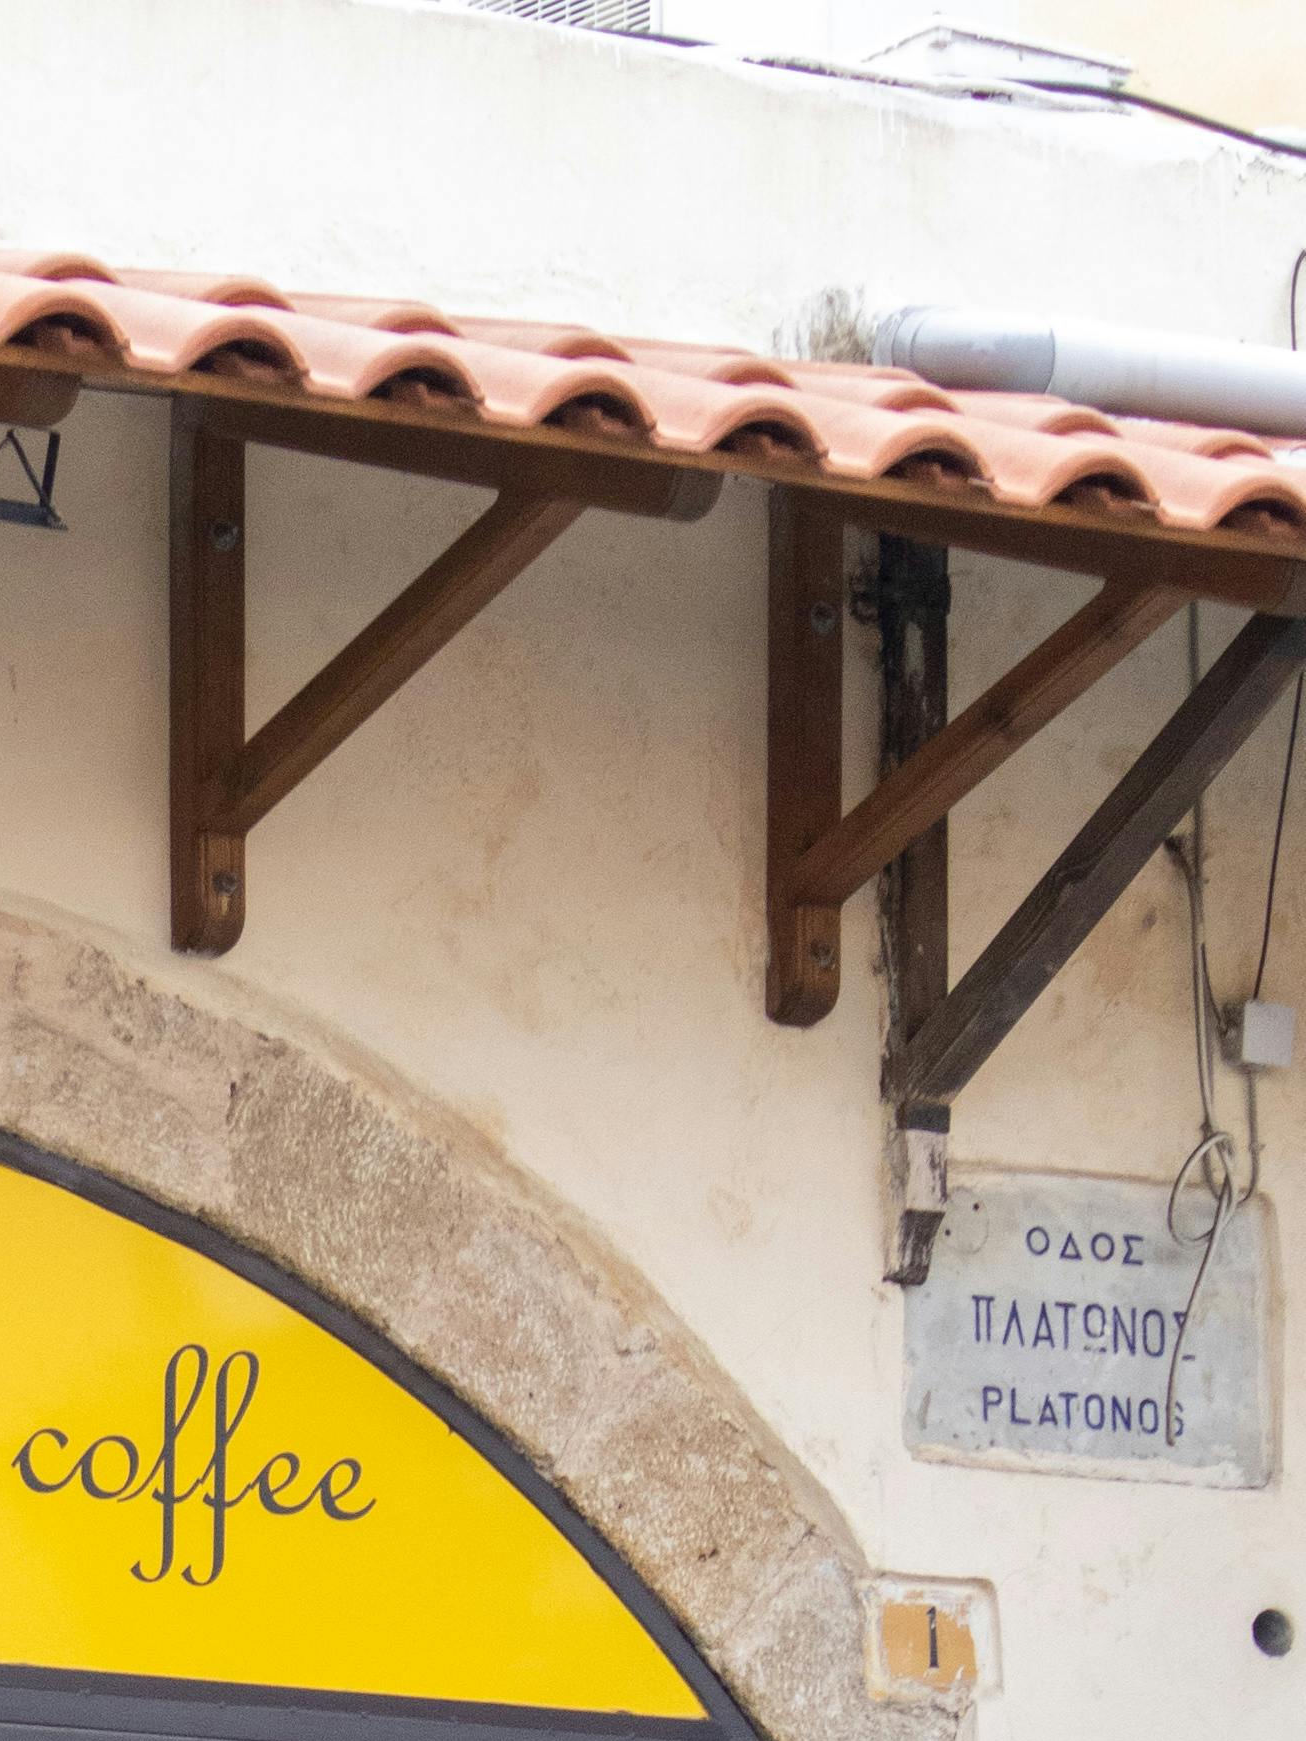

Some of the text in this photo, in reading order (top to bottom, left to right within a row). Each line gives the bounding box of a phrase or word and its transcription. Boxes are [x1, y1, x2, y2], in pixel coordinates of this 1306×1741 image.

[1025, 1226, 1144, 1267] ΟΔΟΣ
[11, 1344, 377, 1587] coffee
[925, 1605, 940, 1669] 1
